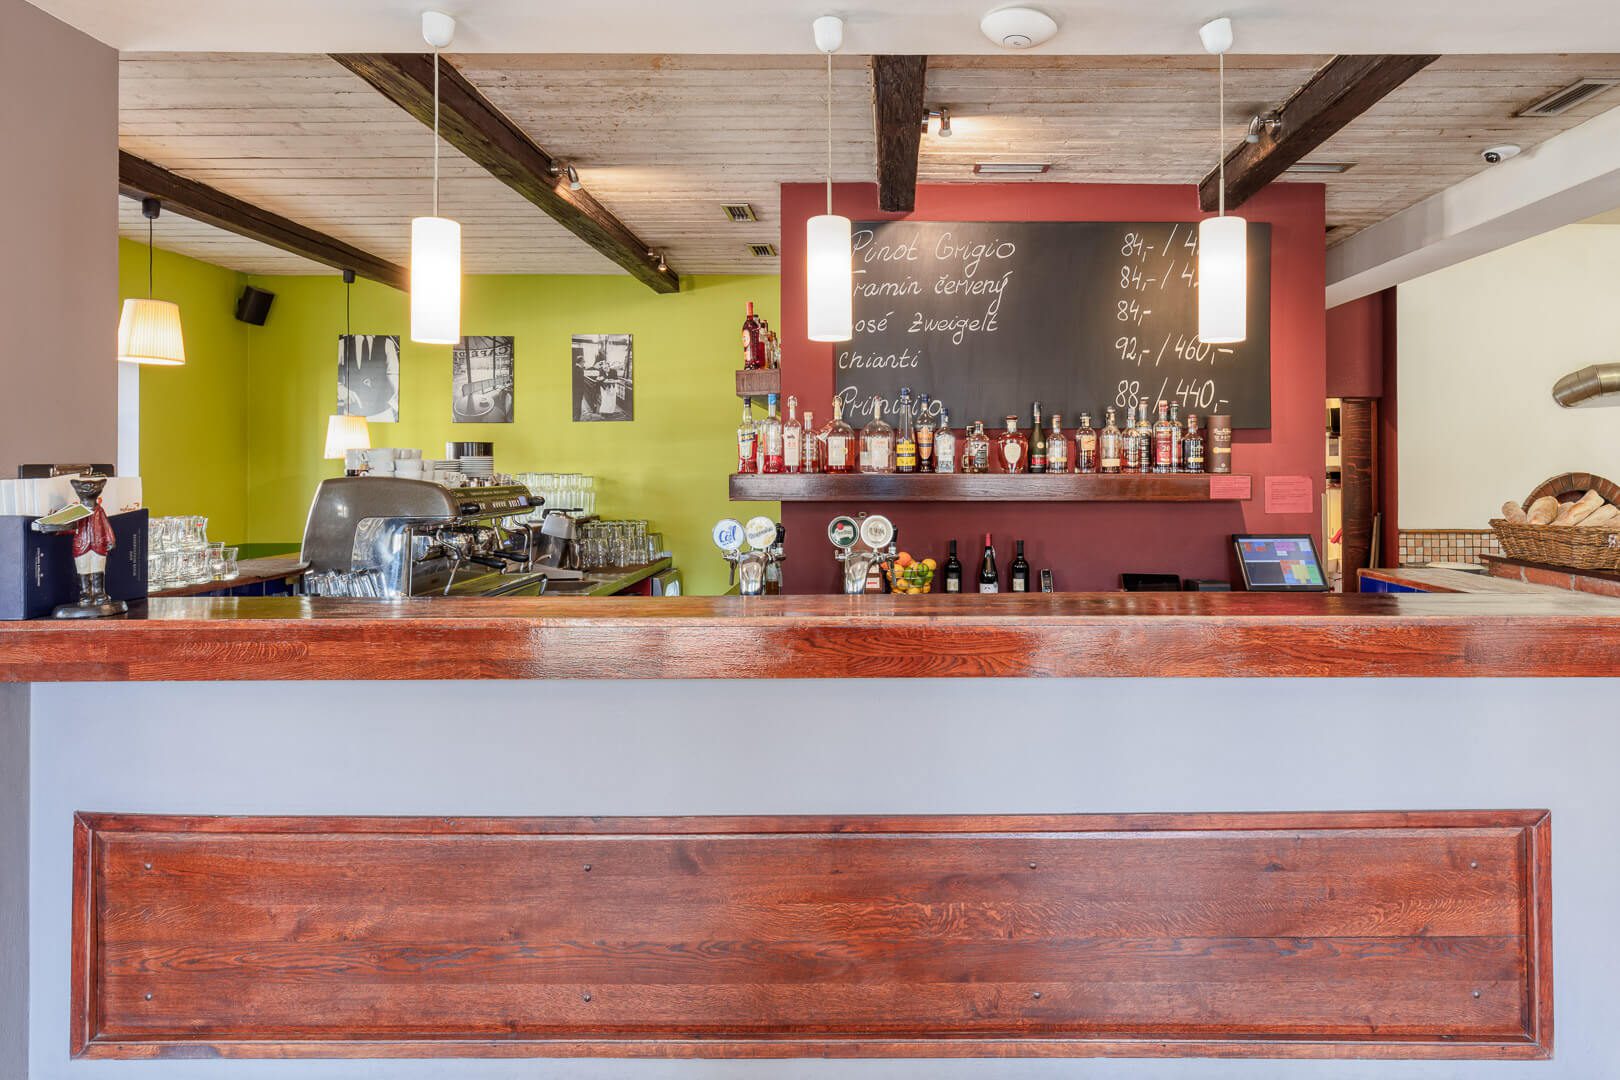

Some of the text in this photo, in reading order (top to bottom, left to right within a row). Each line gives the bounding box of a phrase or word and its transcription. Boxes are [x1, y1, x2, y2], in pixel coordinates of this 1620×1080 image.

[850, 229, 920, 263] Pinot
[936, 232, 1016, 278] Grigio
[934, 271, 1014, 316] červený
[851, 311, 895, 334] osé
[838, 385, 943, 417] Primiio
[1176, 378, 1229, 413] 440,-
